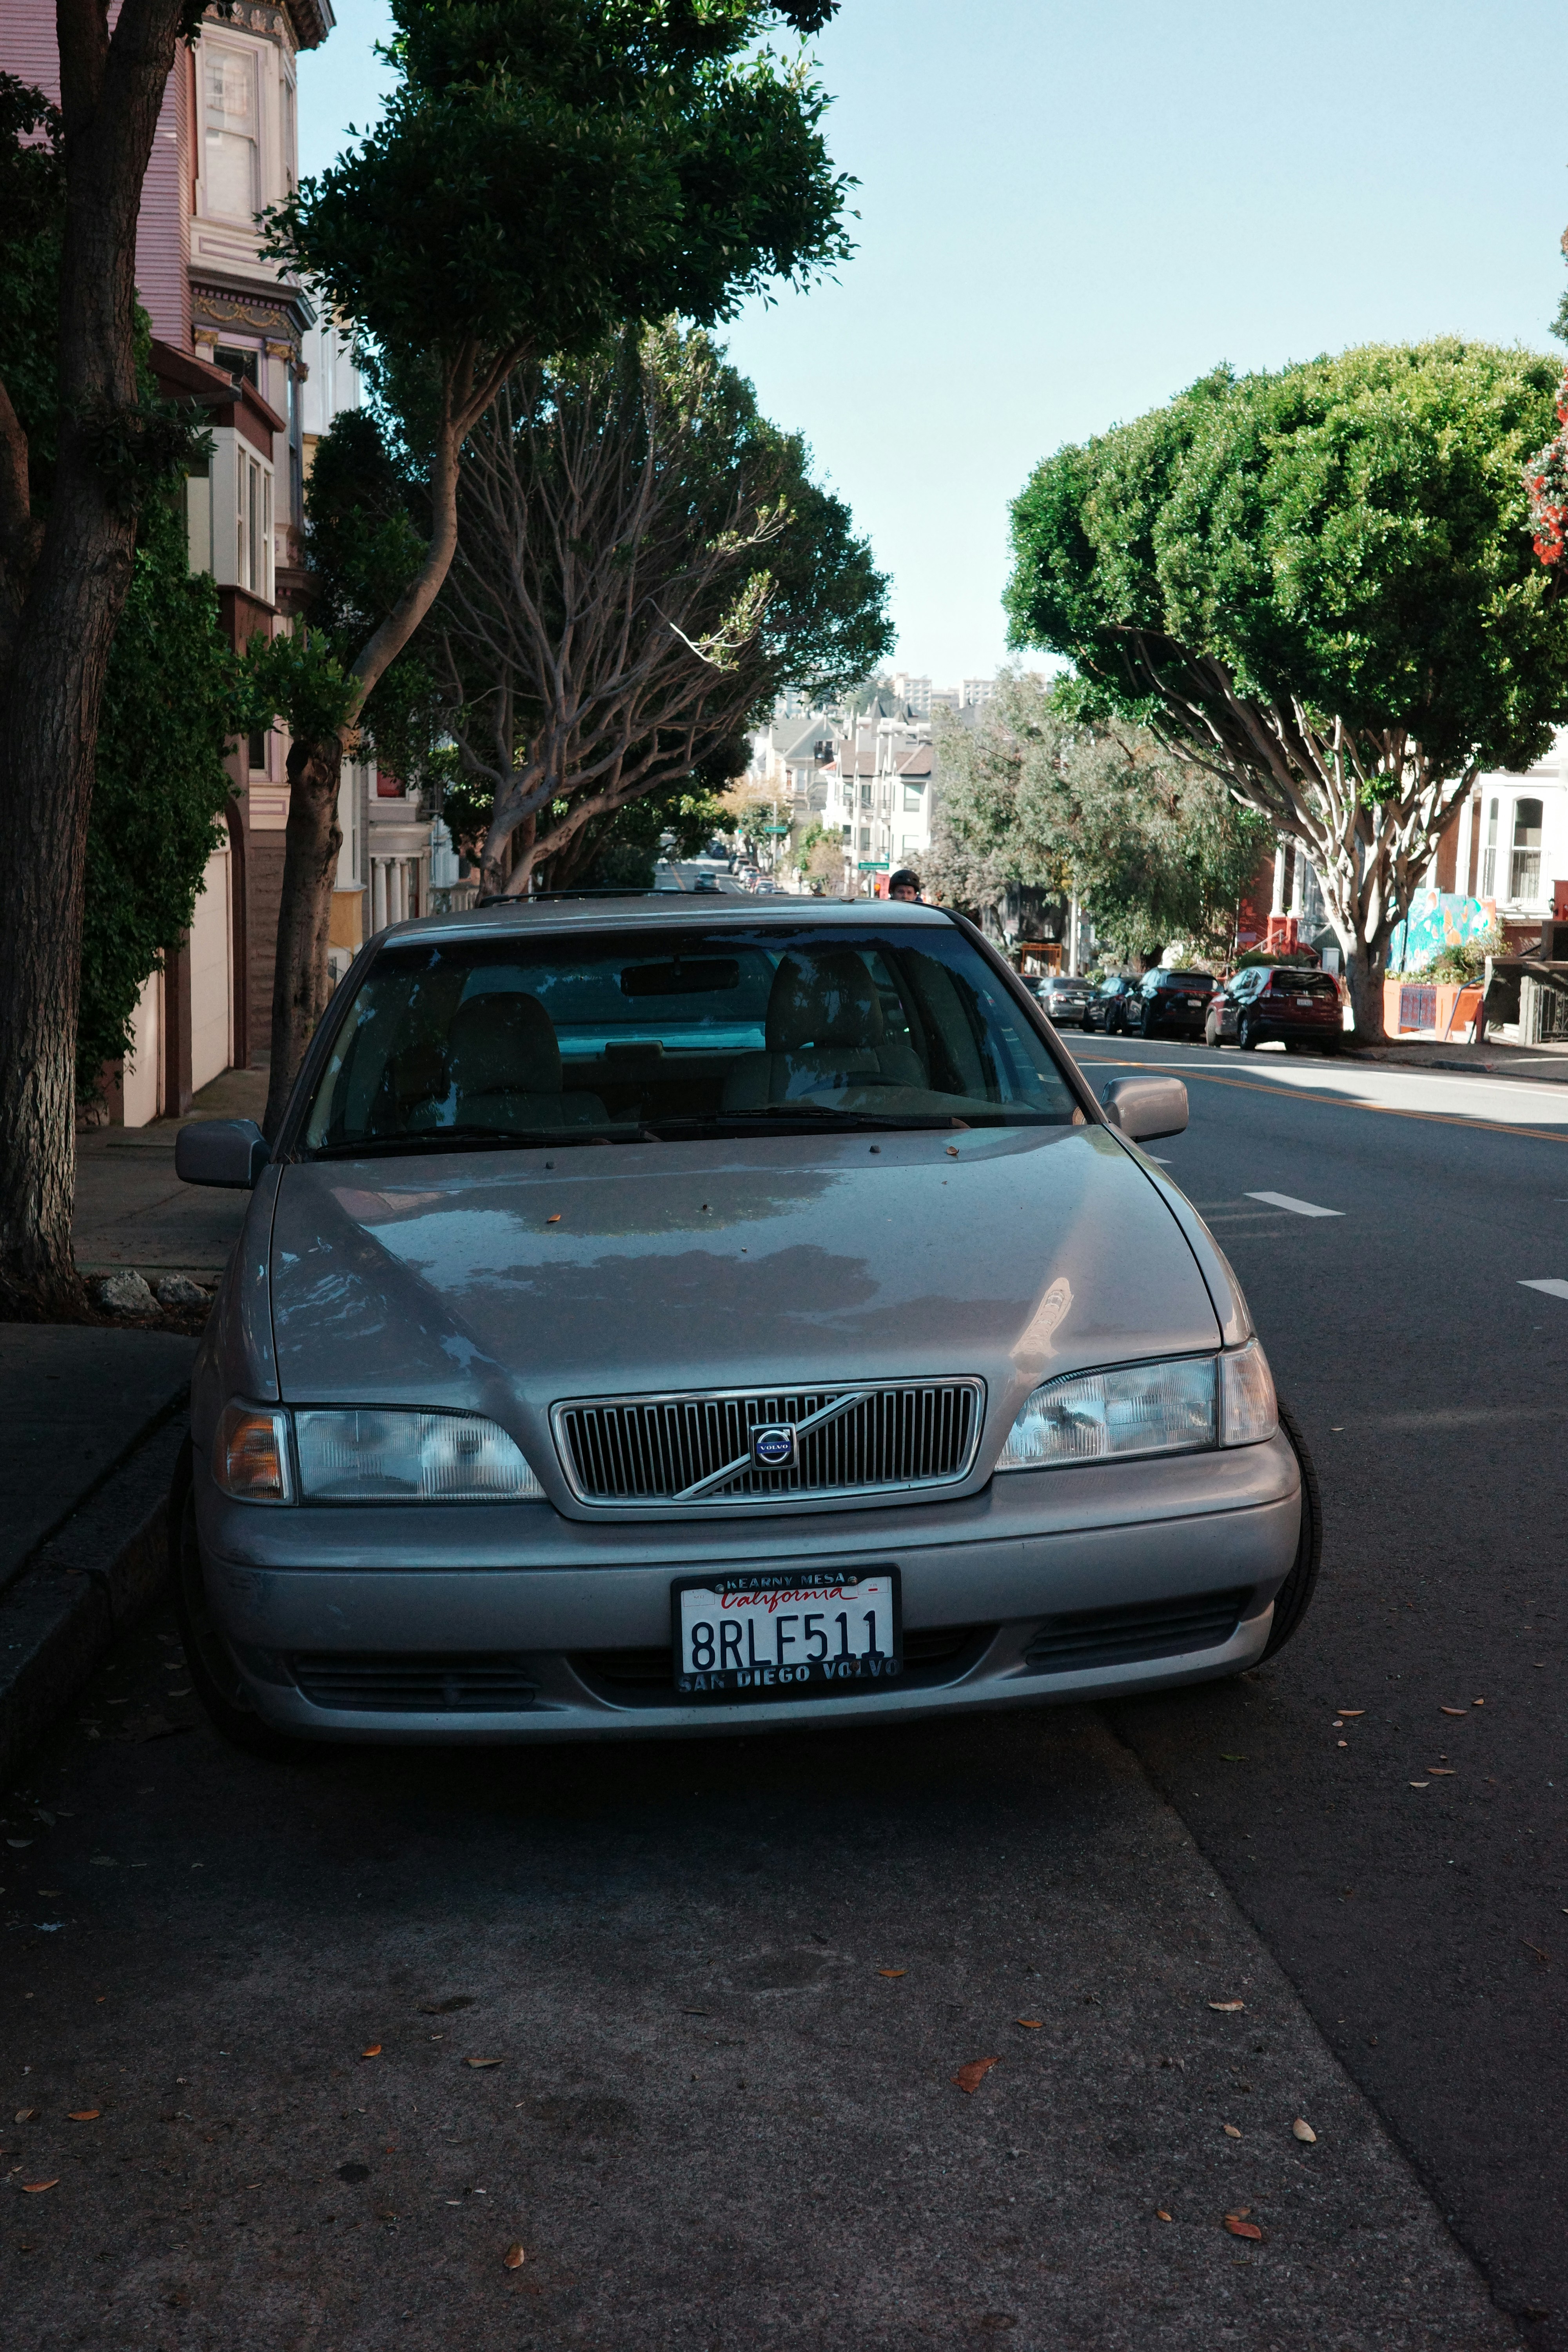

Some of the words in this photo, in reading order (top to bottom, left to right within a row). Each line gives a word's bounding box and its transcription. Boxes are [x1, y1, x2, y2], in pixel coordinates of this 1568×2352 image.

[727, 1576, 793, 1589] KEARNY
[801, 1573, 846, 1586] MESA
[721, 1586, 858, 1613] California
[691, 1610, 885, 1671] 8RLF511
[678, 1673, 725, 1693] SAN
[737, 1666, 810, 1688] DIEGO
